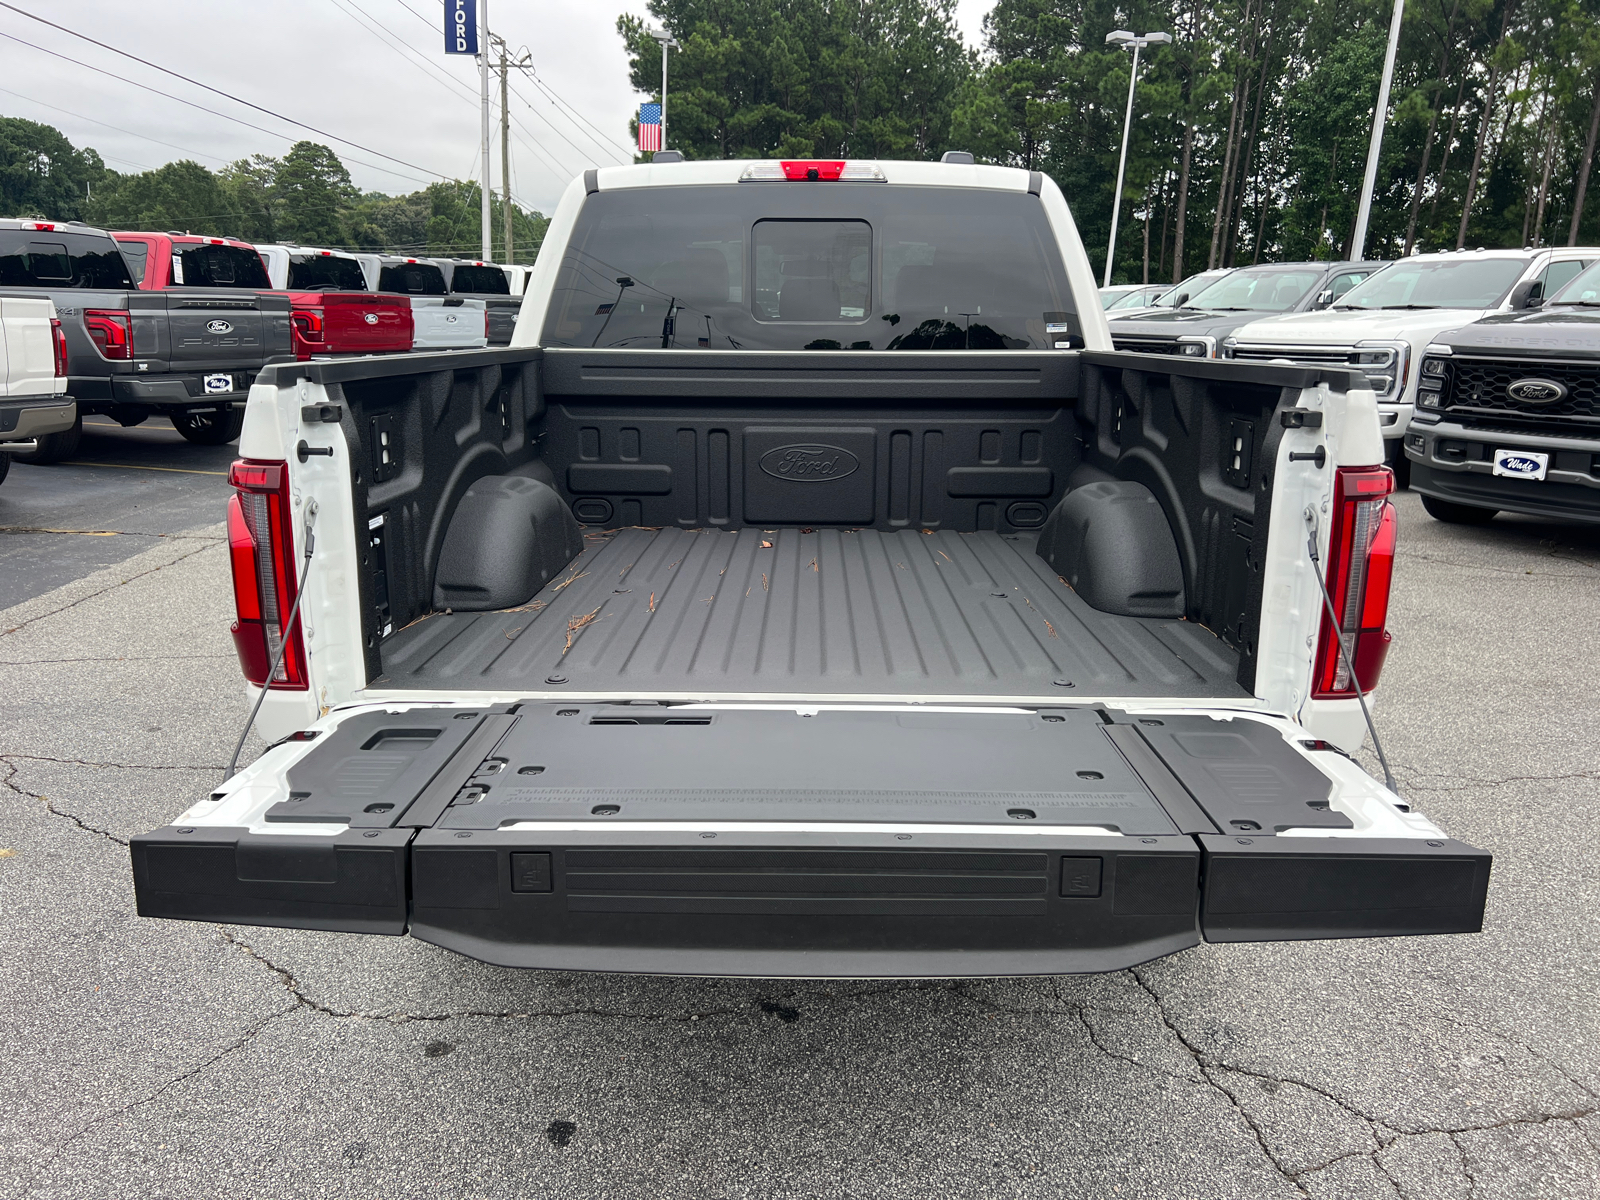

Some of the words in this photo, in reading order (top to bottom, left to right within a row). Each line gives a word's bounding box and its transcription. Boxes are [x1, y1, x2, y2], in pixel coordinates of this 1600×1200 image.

[455, 0, 467, 51] FORD
[178, 337, 260, 348] F-150
[1475, 336, 1559, 346] SUPER
[1520, 385, 1549, 399] Ford
[777, 449, 839, 475] Ford
[1507, 458, 1534, 470] Wade
